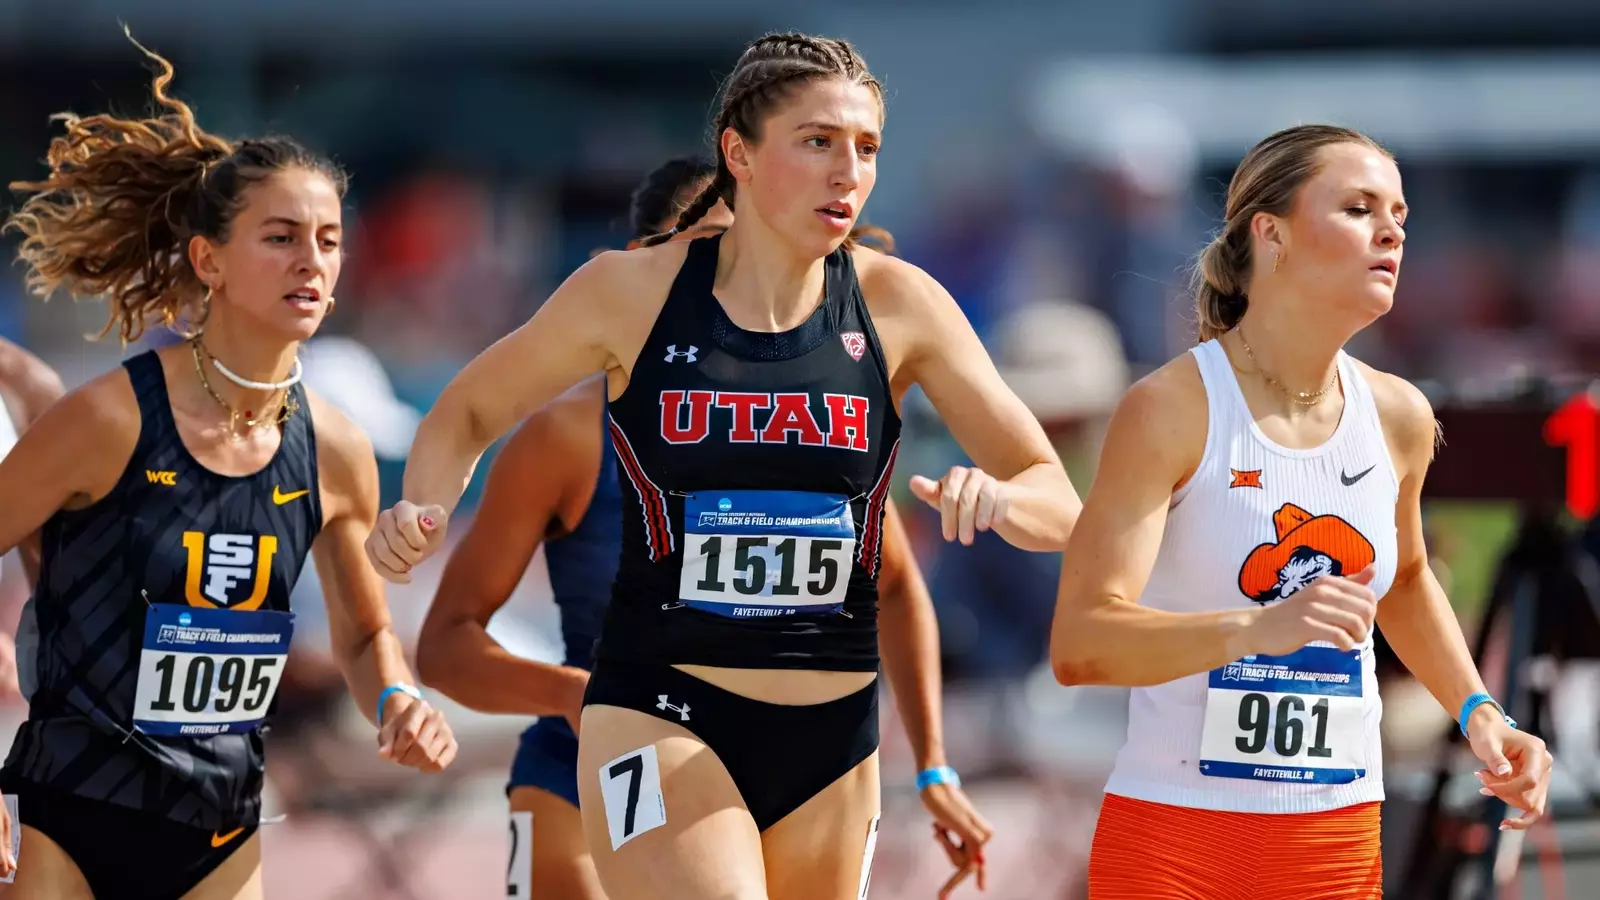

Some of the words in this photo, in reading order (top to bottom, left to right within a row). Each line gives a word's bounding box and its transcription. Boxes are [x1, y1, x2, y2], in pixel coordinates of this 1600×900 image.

[850, 344, 863, 355] 12
[659, 390, 869, 452] UTAH
[145, 469, 177, 485] WCC
[717, 517, 743, 525] TRACK
[744, 517, 751, 526] &
[752, 517, 774, 526] FIELD
[775, 517, 840, 526] CHAMPIONSHIPS
[697, 536, 842, 596] 1515
[176, 630, 200, 641] TRACK
[206, 632, 226, 643] FIELD
[226, 633, 281, 643] CHAMPIONSHIPS
[150, 654, 277, 713] 1095
[1241, 667, 1267, 678] TRACK
[1268, 669, 1274, 679] &
[1274, 670, 1294, 680] FIELD
[1294, 671, 1351, 684] CHAMPIONSHIPS
[1235, 693, 1332, 757] 961
[1303, 771, 1315, 780] AR
[609, 754, 643, 838] 7
